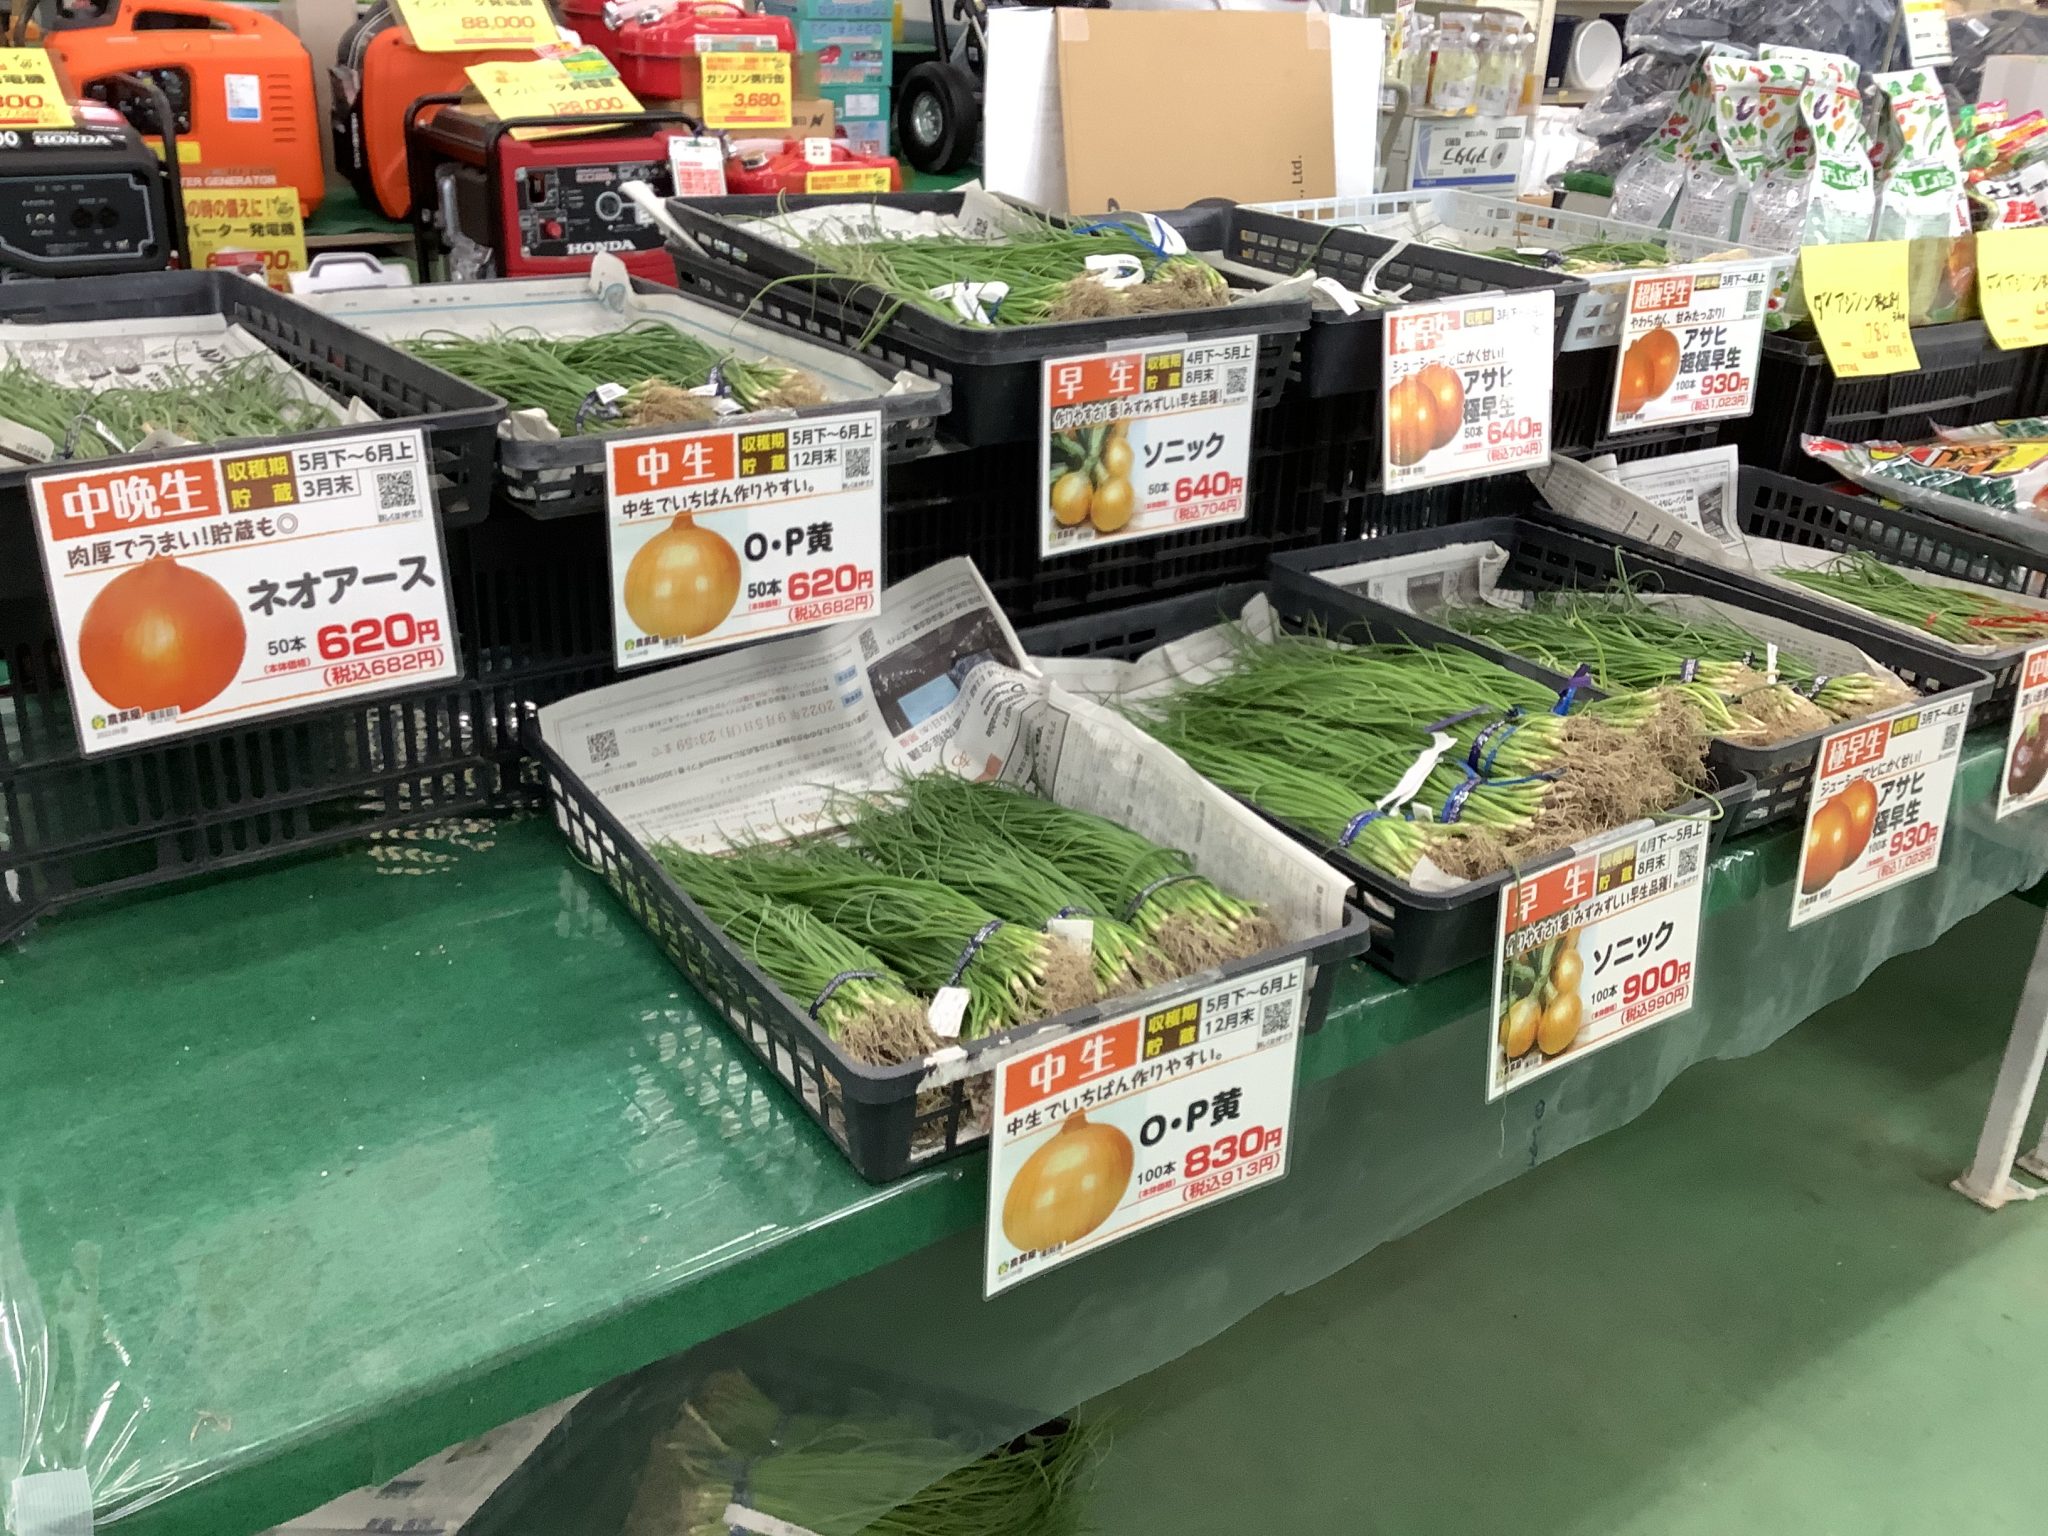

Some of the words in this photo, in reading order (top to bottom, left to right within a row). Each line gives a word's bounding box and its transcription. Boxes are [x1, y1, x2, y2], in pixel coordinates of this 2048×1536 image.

[462, 16, 535, 30] 88,000
[734, 93, 780, 108] 3,680
[34, 134, 112, 146] HONDA
[204, 175, 277, 187] GENERATOR
[1291, 155, 1304, 184] Ltd.
[567, 240, 636, 254] HONDA
[1634, 279, 1690, 309] 超極早生
[1684, 325, 1728, 350] アサヒ
[1186, 368, 1214, 384] 8月末
[1679, 346, 1742, 375] 超極早生
[1057, 361, 1134, 400] 早生
[1464, 366, 1513, 394] アサヒ
[1701, 372, 1749, 395] 930円
[1464, 426, 1484, 438] 50本
[1487, 417, 1542, 444] 640円
[637, 442, 715, 487] 中生
[741, 432, 786, 454] 収穫期
[742, 455, 786, 475] 貯蔵
[793, 449, 838, 467] 12月末
[1144, 432, 1225, 468] ソニック
[63, 470, 208, 531] 中晩生
[227, 458, 289, 483] 収穫期
[230, 488, 293, 508] 貯蔵
[302, 475, 355, 498] 3月末
[622, 478, 815, 519] 中生でいちばん作りやすい。
[1148, 482, 1170, 496] 50本
[1175, 471, 1243, 503] 640円
[1174, 498, 1241, 522] (税込704円)
[247, 555, 436, 616] ネオアース
[748, 579, 782, 598] 50本
[788, 564, 874, 601] 620円
[788, 595, 875, 623] (税込682円)
[268, 636, 307, 658] 50本
[317, 613, 440, 660] 620円
[323, 649, 445, 687] (税込682円)
[1828, 728, 1884, 772] 極早生
[1878, 770, 1925, 807] アサヒ
[1873, 798, 1922, 838] 極早生
[1889, 821, 1939, 857] 930円
[1637, 854, 1667, 876] 8月末
[1513, 864, 1589, 922] 早生
[1593, 921, 1674, 976] ソニック
[1591, 984, 1618, 1005] 100本
[1622, 959, 1691, 1004] 900円
[1620, 984, 1690, 1026] (税込990円)
[1030, 1035, 1116, 1094] 中生
[1148, 1003, 1198, 1033] 収穫期
[1146, 1027, 1196, 1058] 貯蔵
[1204, 1007, 1256, 1037] 12月末
[1006, 1048, 1224, 1137] 中生でいちばん作りやすい。
[1137, 1161, 1177, 1185] 100本
[1184, 1125, 1283, 1179] 830円
[1182, 1152, 1281, 1202] (税込913円)
